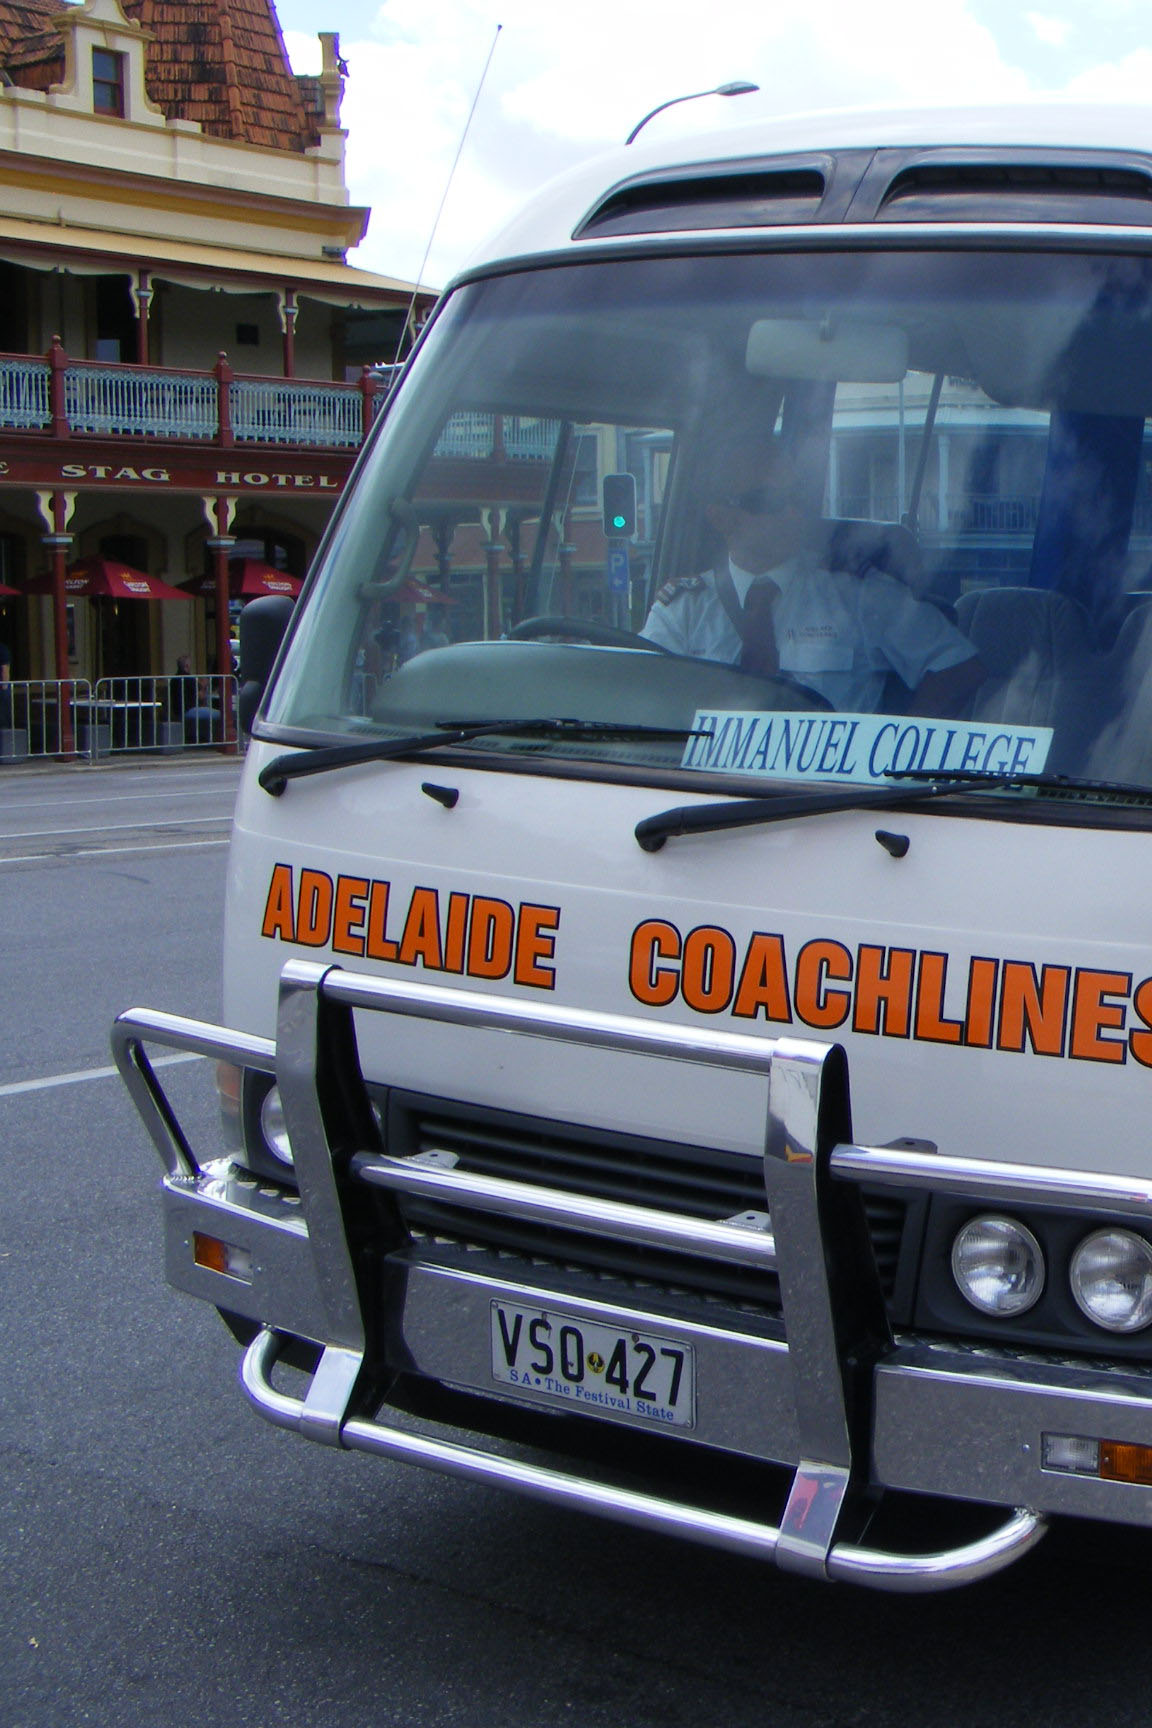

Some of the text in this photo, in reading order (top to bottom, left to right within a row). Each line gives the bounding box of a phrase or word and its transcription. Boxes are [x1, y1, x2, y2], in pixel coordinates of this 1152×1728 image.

[60, 464, 171, 482] STAG
[215, 471, 338, 488] HOTEL
[684, 715, 1037, 790] IMMANUEL COLLEGE
[261, 862, 562, 991] ADELAIDE
[496, 1308, 685, 1407] VSO 427
[545, 1377, 571, 1396] The
[575, 1385, 631, 1410] Festival
[636, 1400, 675, 1421] State
